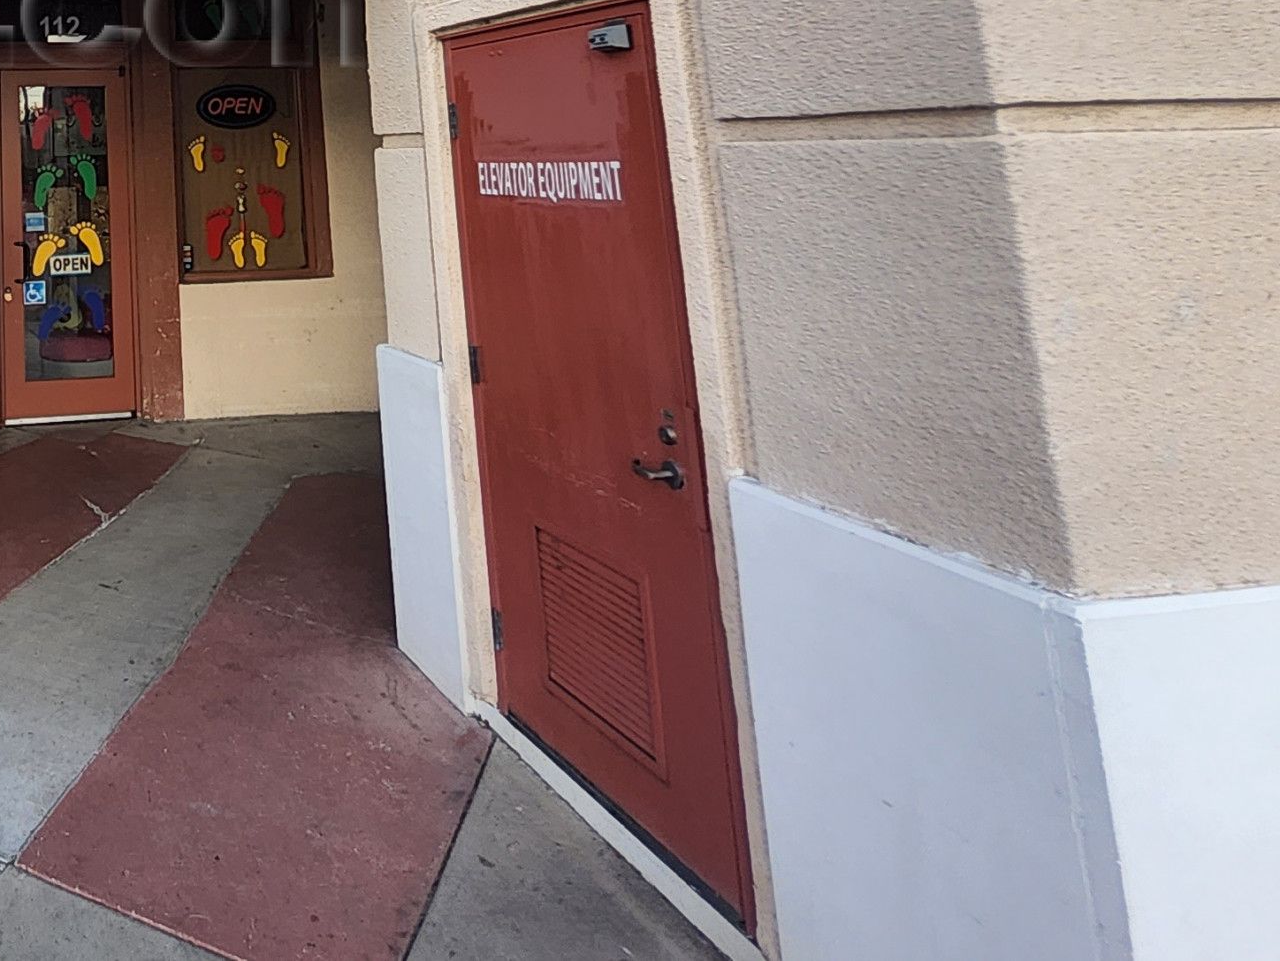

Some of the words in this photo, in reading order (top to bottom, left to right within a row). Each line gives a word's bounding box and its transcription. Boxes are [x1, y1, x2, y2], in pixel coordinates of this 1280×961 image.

[40, 16, 80, 38] 112
[207, 97, 264, 116] OPEN
[477, 161, 537, 198] ELEVATOR
[537, 160, 622, 204] EQUIPMENT
[53, 256, 88, 272] OPEN
